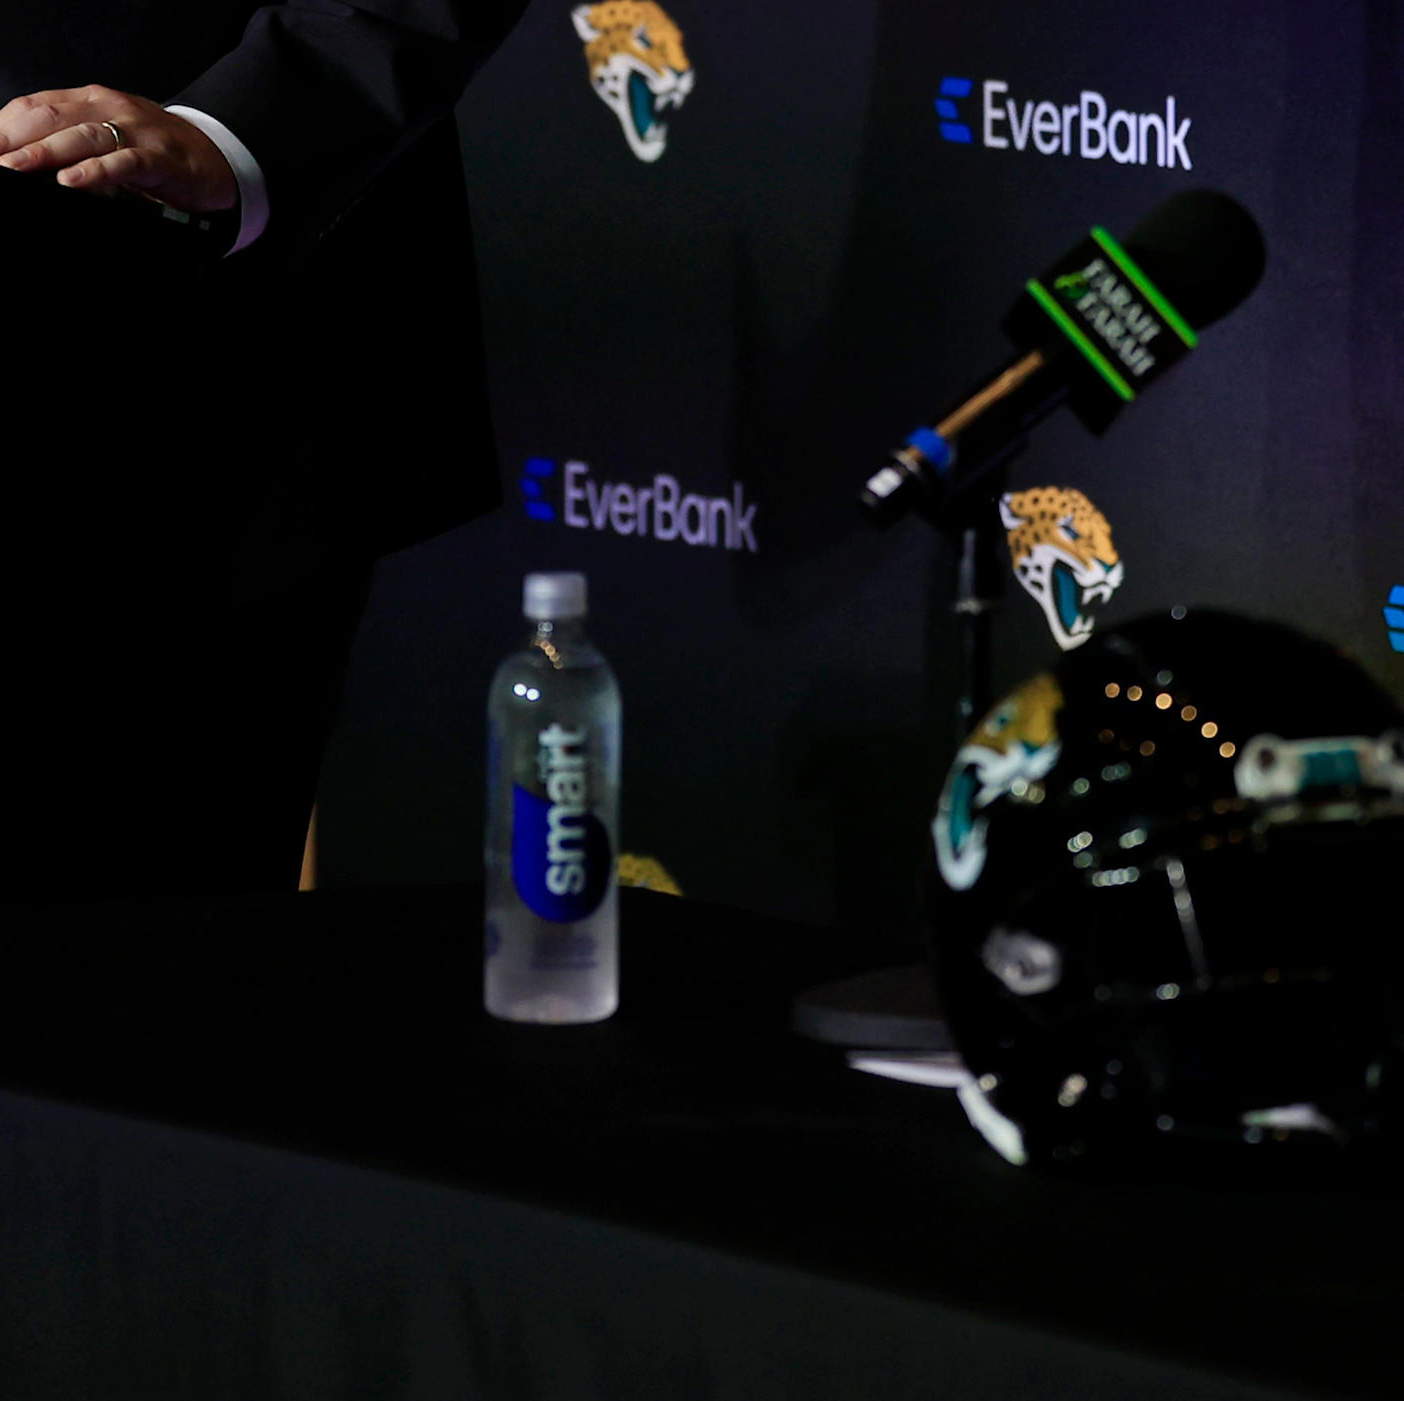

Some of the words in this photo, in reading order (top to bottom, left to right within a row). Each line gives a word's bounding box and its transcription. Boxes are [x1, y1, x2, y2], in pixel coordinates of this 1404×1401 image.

[983, 80, 1192, 171] EverBank
[564, 460, 755, 550] EverBank
[538, 723, 586, 897] smart
